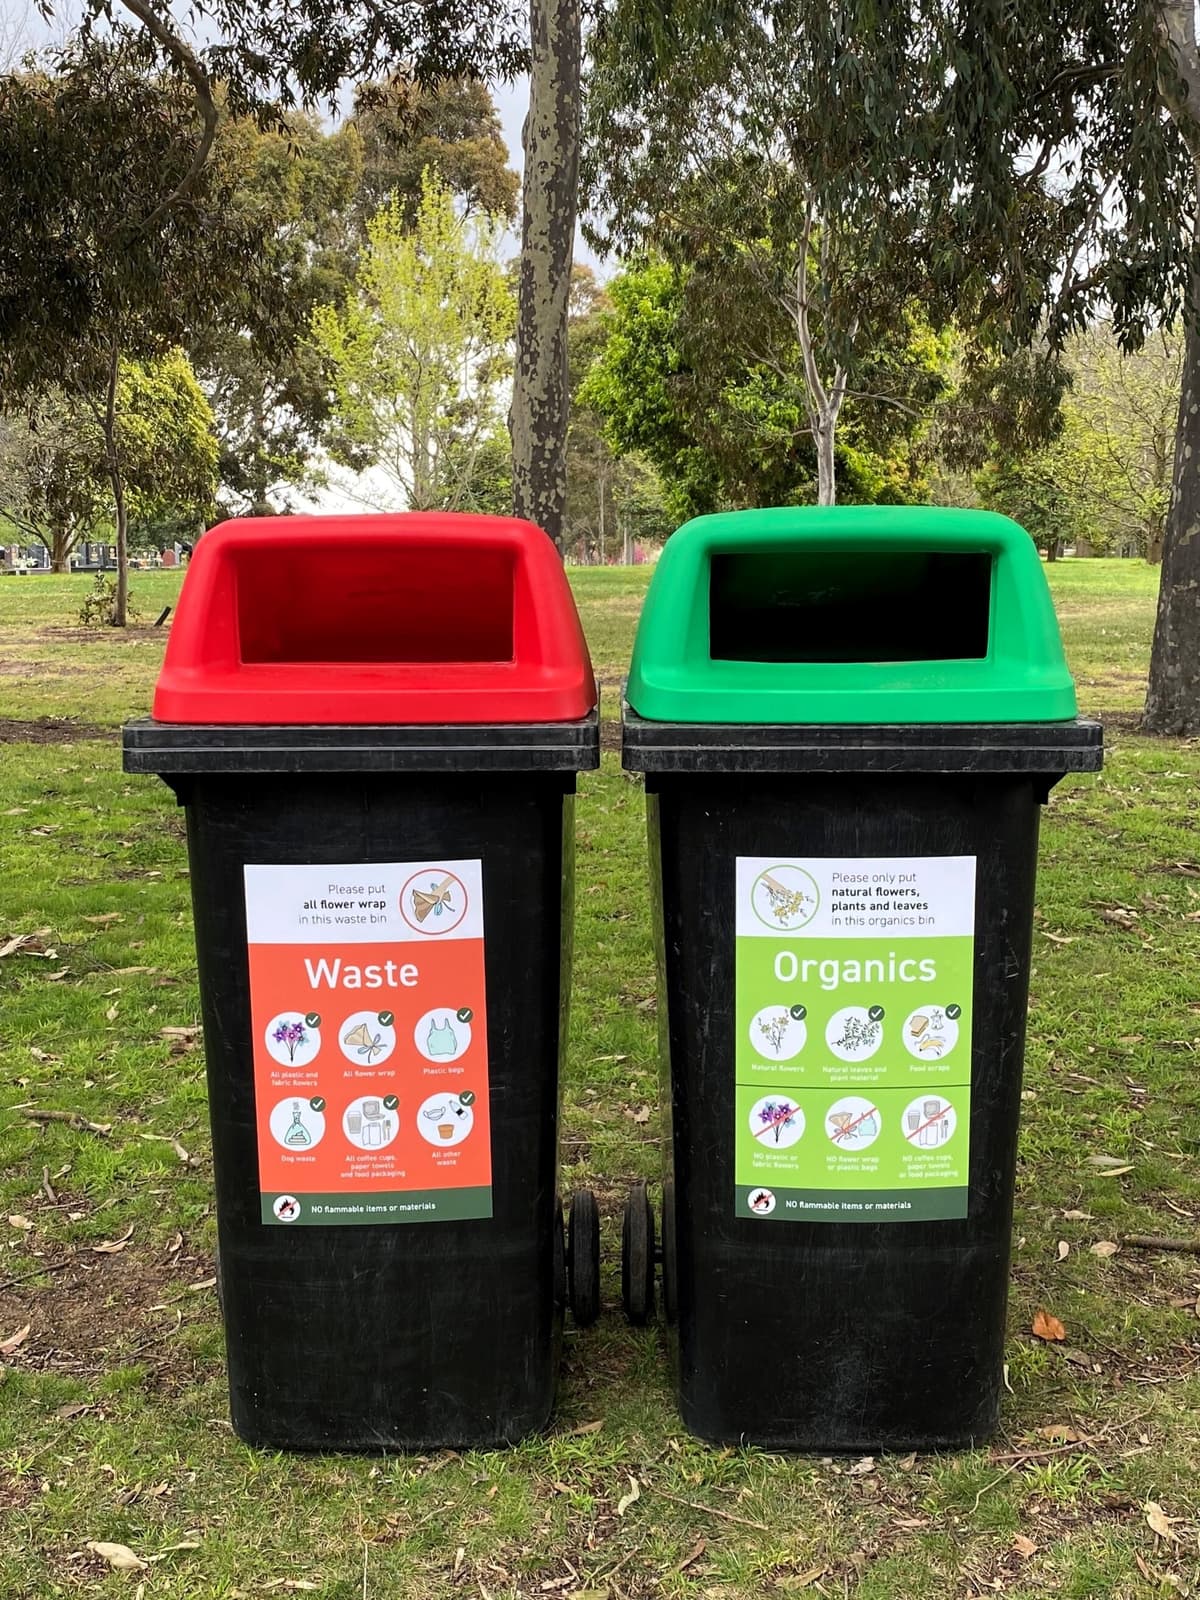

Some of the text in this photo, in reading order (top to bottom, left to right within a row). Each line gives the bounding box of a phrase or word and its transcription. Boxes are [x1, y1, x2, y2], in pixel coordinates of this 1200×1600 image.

[833, 873, 916, 884] Please only put
[328, 885, 386, 896] Please put
[832, 887, 920, 897] natural flowers,
[304, 900, 386, 910] all flower wrap
[832, 901, 928, 911] plants and leaves
[299, 914, 386, 924] in this waste bin
[832, 916, 934, 927] in this organics bin
[304, 959, 418, 989] Waste
[775, 951, 936, 991] Organics
[281, 1071, 304, 1079] plastic
[378, 1070, 395, 1078] wrap
[325, 1205, 364, 1213] flammable
[366, 1204, 387, 1212] items
[400, 1202, 435, 1211] materials
[800, 1201, 839, 1210] flammable
[842, 1202, 862, 1210] items
[876, 1201, 912, 1210] materials
